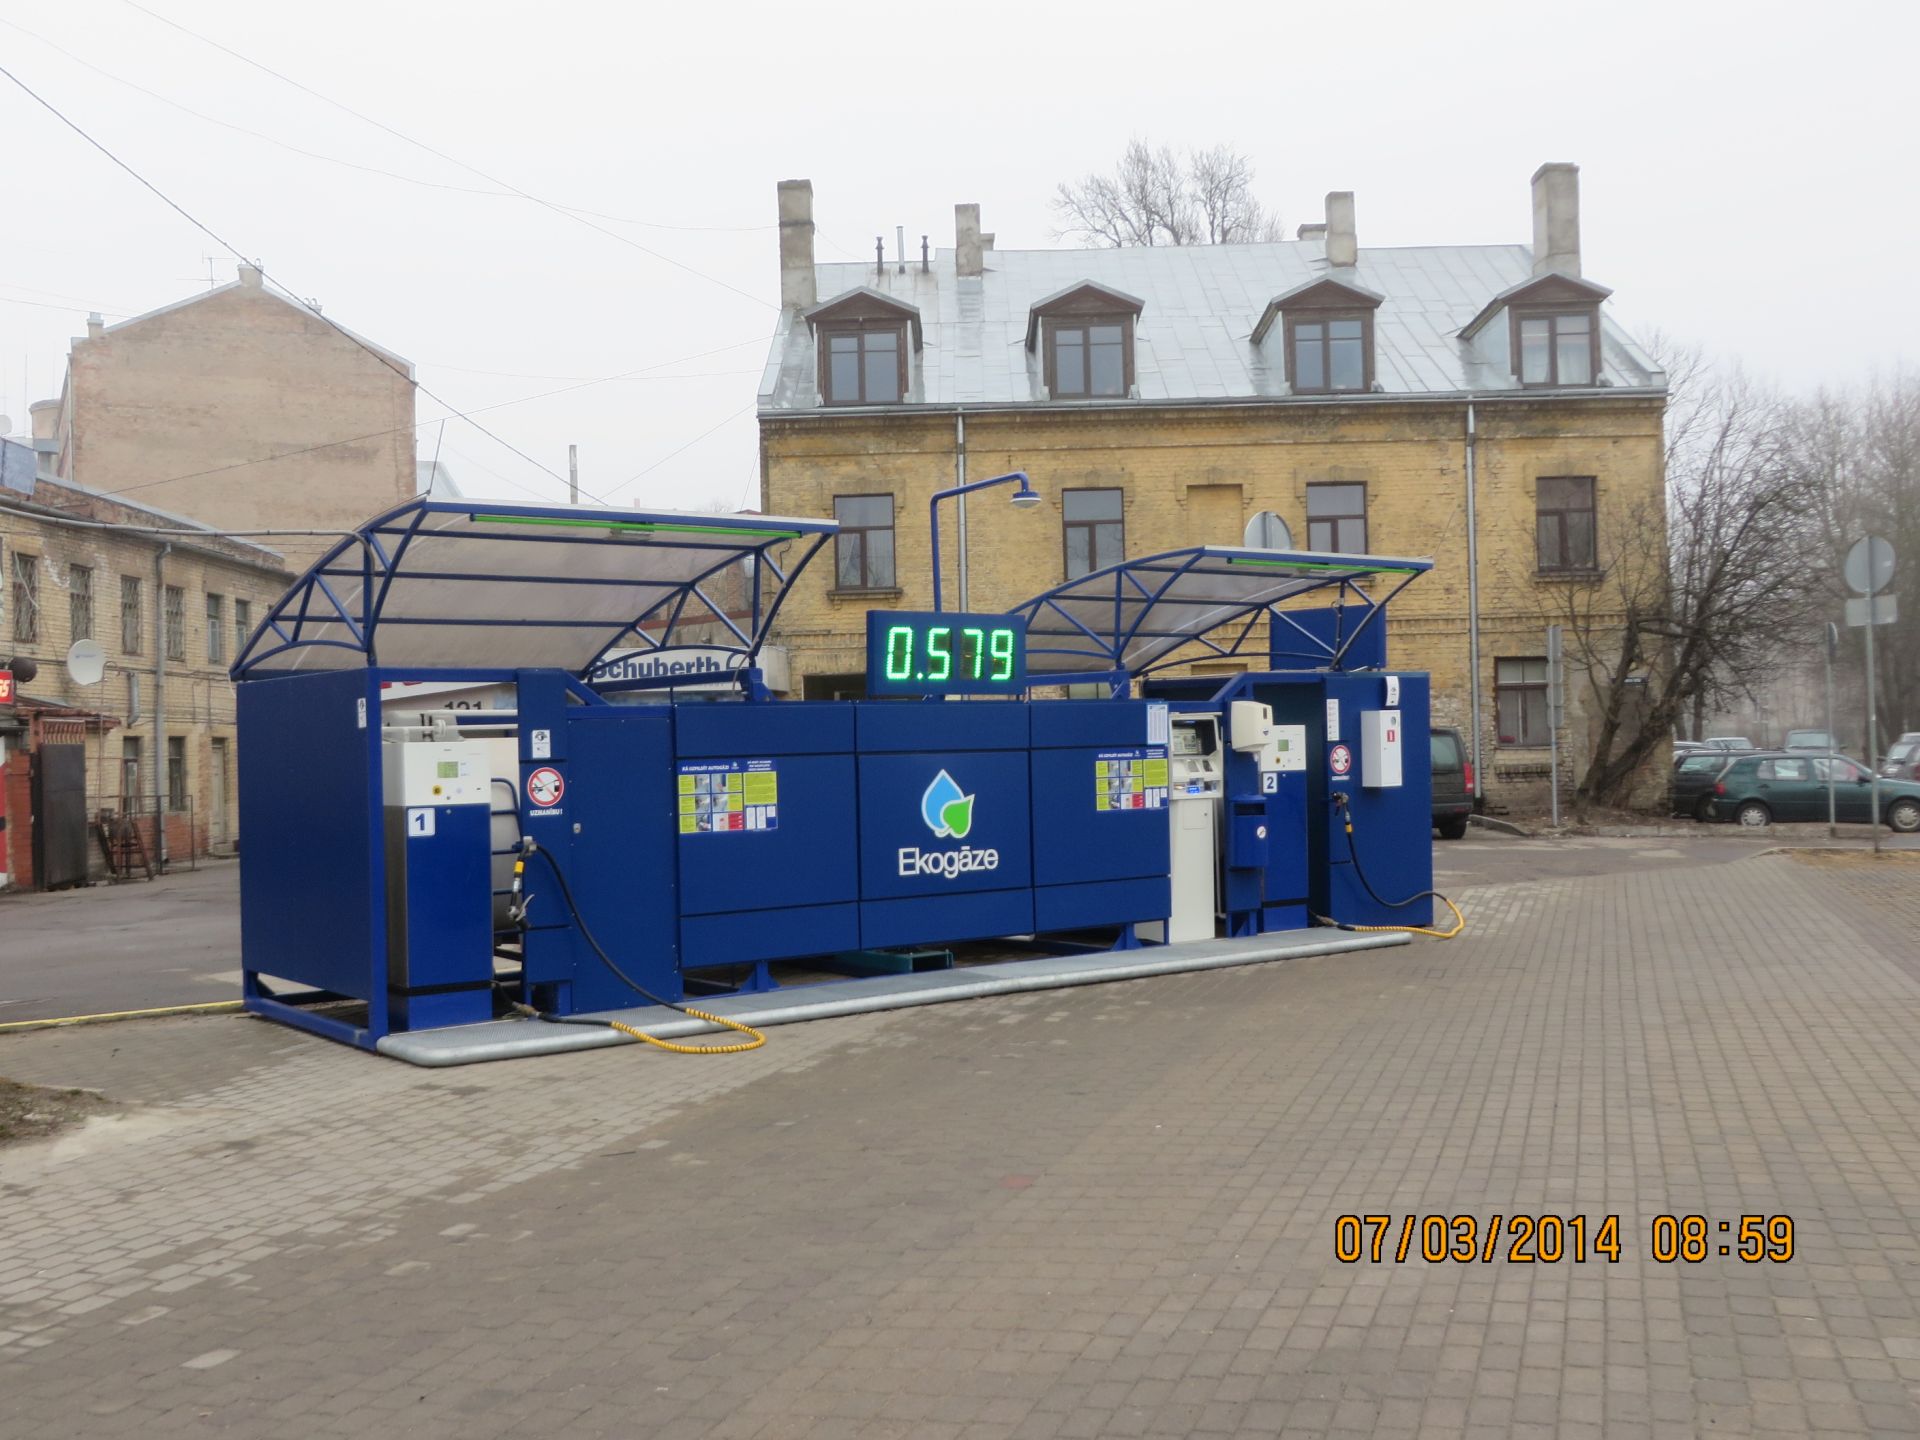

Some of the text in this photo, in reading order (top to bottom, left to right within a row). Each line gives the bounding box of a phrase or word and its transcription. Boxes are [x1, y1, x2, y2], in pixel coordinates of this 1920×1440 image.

[886, 626, 1014, 680] 0.579
[590, 656, 721, 679] Schuberth
[1266, 776, 1274, 789] 2
[415, 813, 425, 831] 1
[898, 845, 999, 879] Ekogāze
